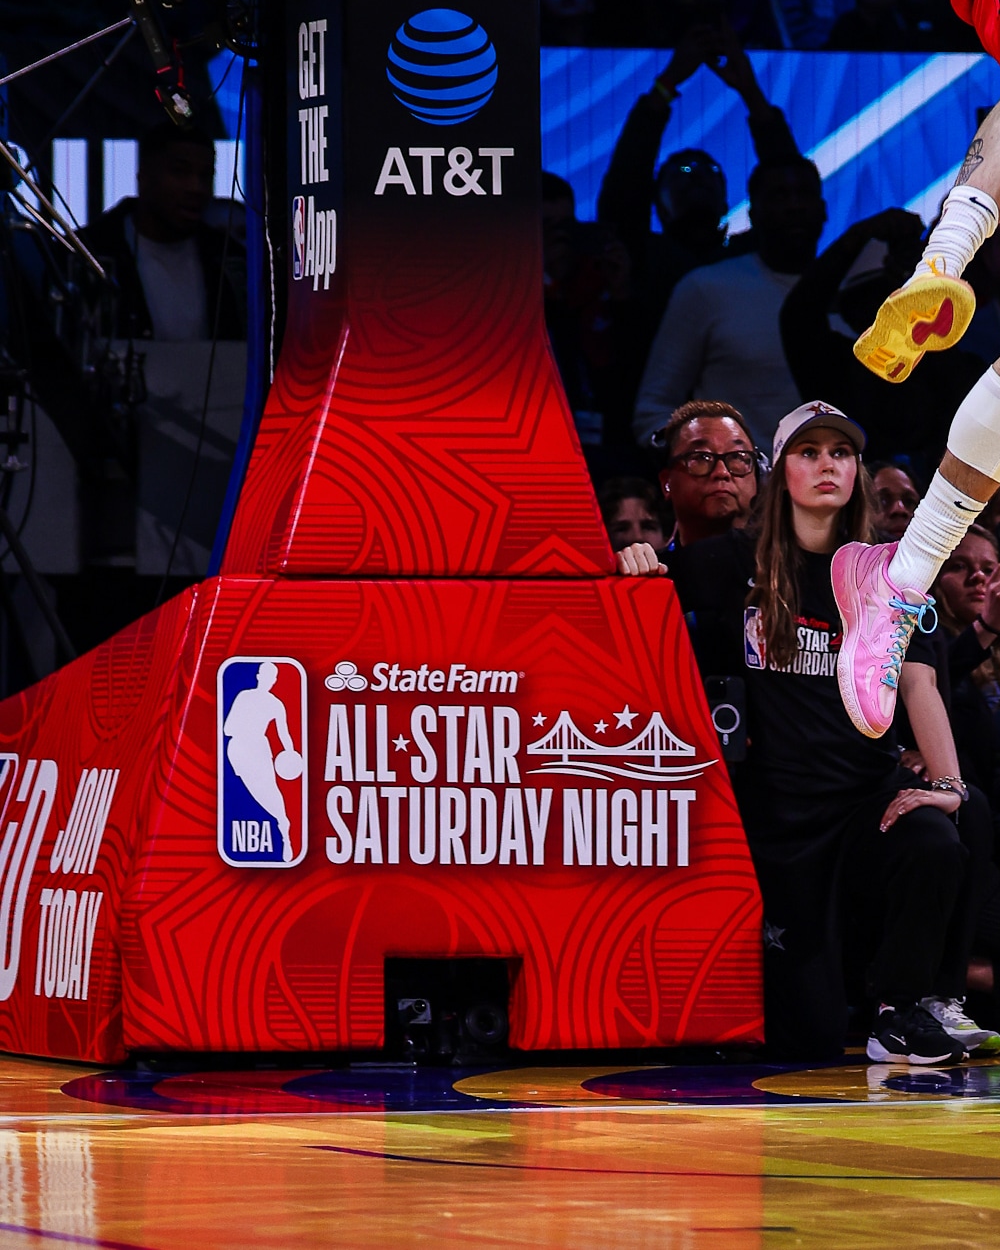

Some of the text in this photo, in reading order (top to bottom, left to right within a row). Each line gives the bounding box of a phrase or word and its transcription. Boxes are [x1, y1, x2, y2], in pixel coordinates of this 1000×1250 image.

[298, 18, 328, 101] GET
[298, 104, 330, 185] THE
[374, 146, 515, 197] AT&T
[304, 195, 338, 292] App
[370, 662, 445, 693] State
[769, 650, 838, 677] URDAY
[50, 767, 120, 875] JOIN
[231, 820, 274, 854] NBA
[325, 786, 697, 868] SATURDAY NIGHT
[34, 887, 103, 1001] TODAY
